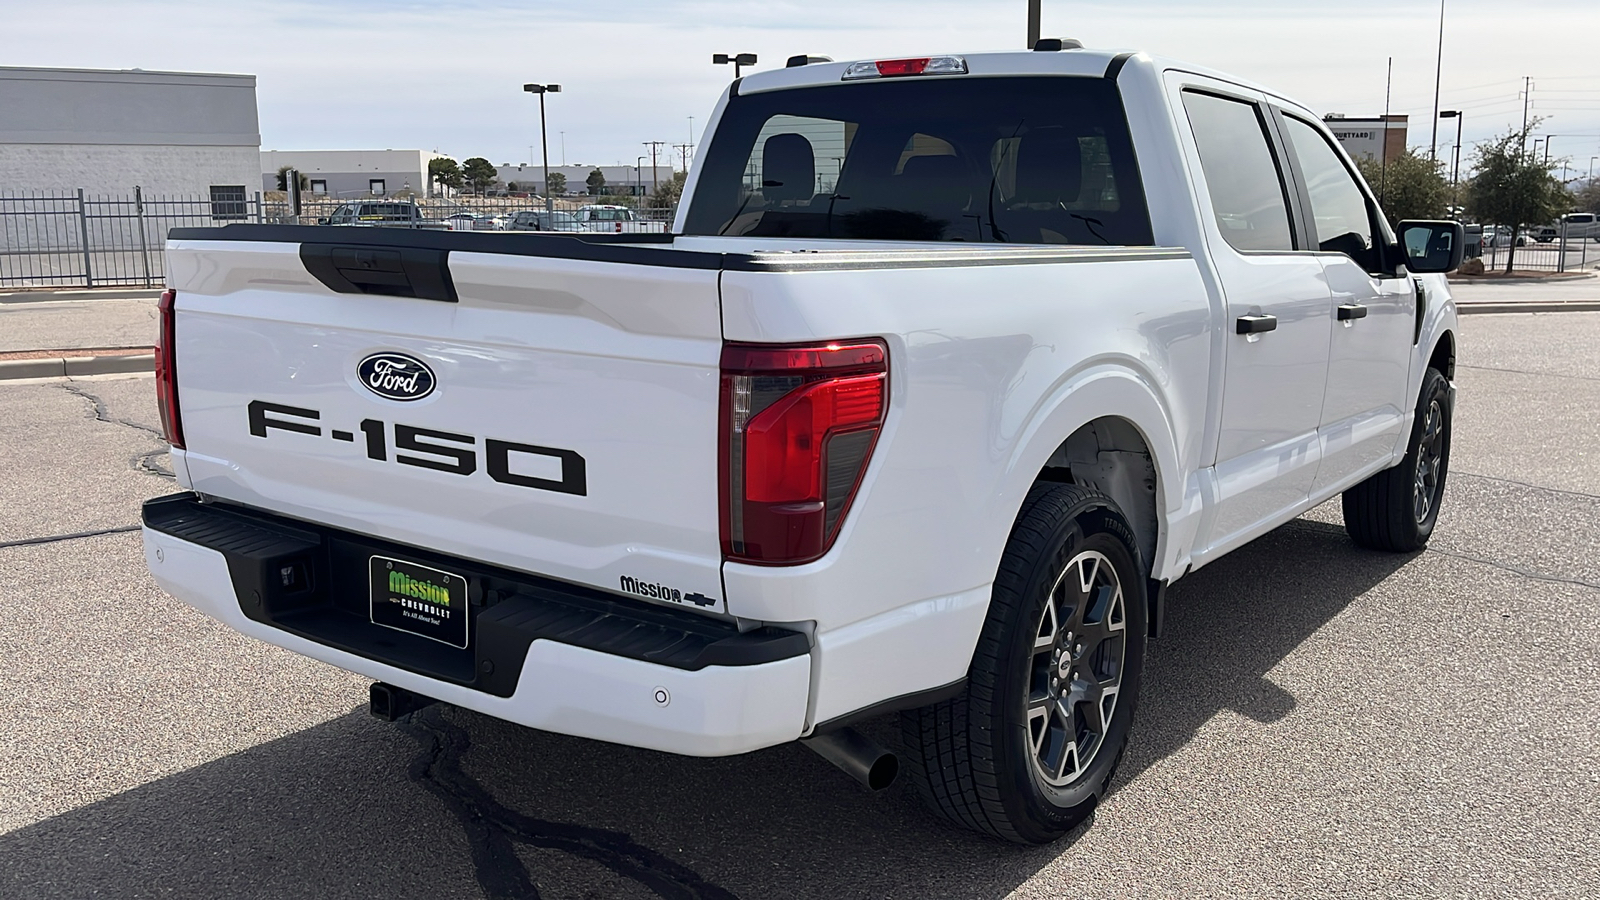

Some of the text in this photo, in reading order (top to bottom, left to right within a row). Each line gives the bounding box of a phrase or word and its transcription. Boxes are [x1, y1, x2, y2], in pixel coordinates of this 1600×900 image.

[369, 359, 419, 394] Ford
[247, 400, 588, 497] F-150
[401, 598, 450, 619] CHEVROLET
